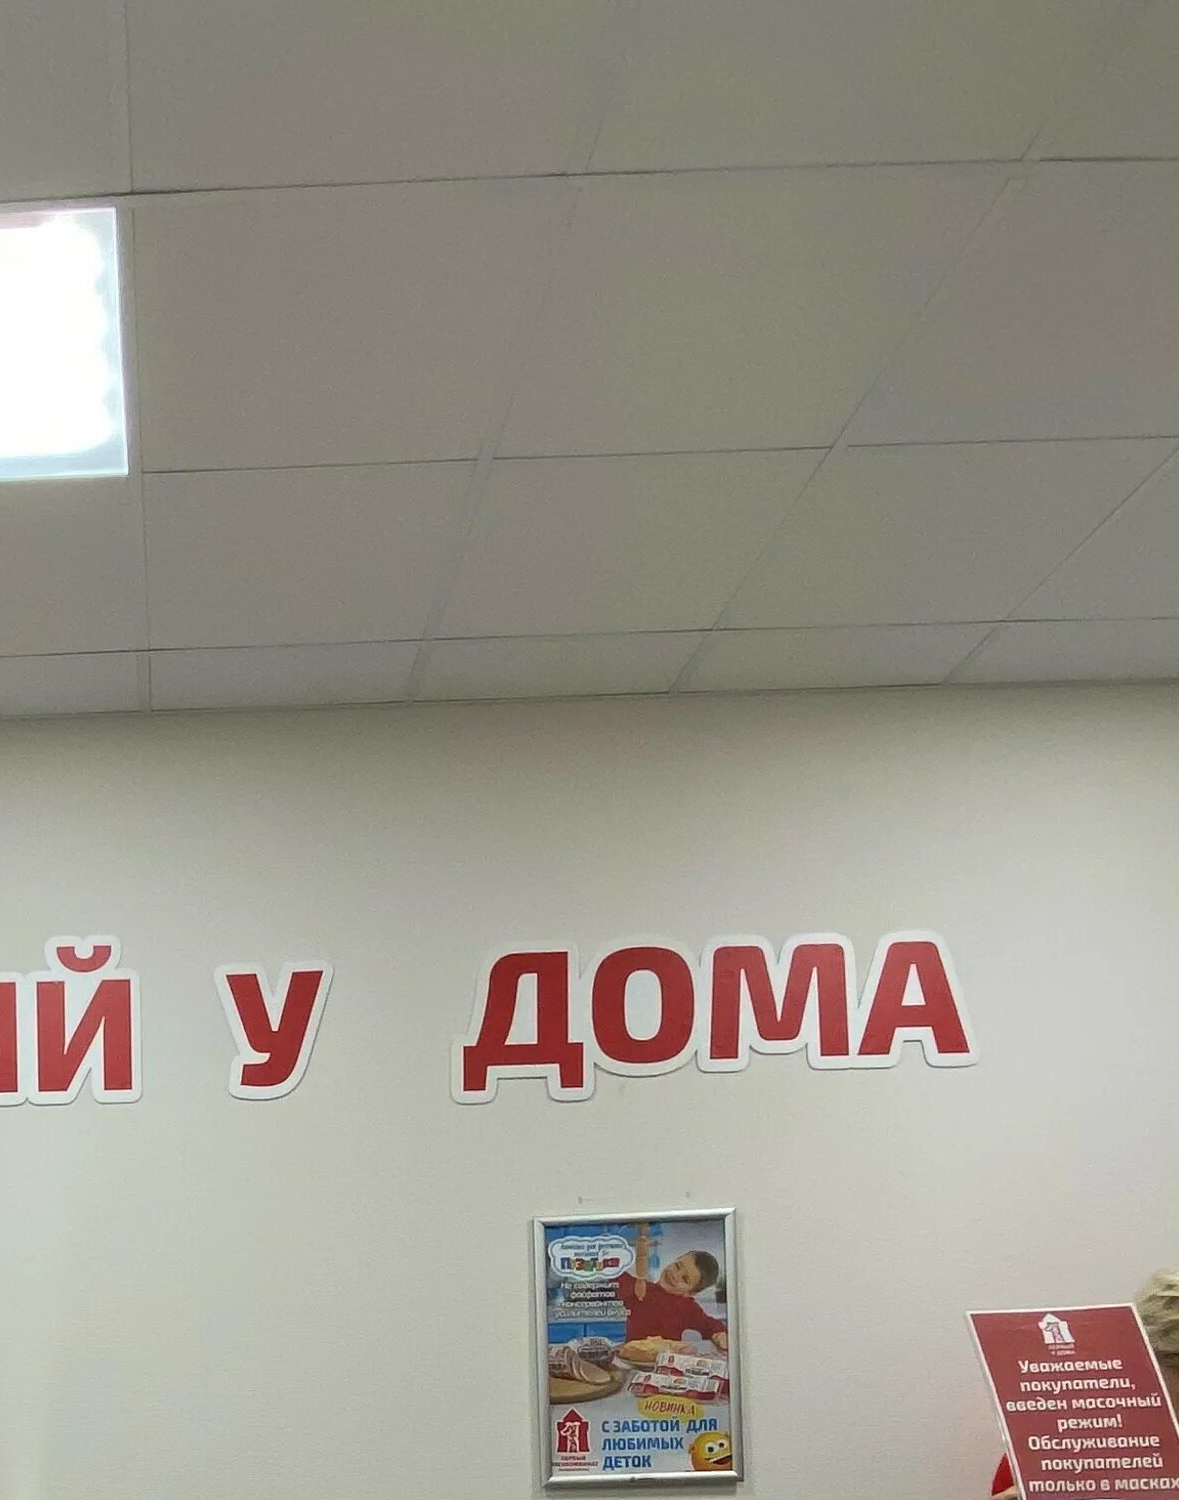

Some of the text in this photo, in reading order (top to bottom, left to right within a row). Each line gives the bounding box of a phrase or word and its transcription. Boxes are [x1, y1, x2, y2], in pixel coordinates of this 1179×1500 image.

[225, 968, 324, 1088] У
[461, 940, 971, 1093] ДОМА
[1017, 1358, 1123, 1374] Уважаемые
[1020, 1378, 1136, 1395] покупатели,
[644, 1401, 695, 1416] НОВИНКА
[1006, 1392, 1162, 1412] введен масочный
[601, 1417, 718, 1434] С ЗАБОТОЙ ДЛЯ
[1057, 1413, 1123, 1433] режим!
[602, 1437, 684, 1451] ЛЮБИМЫХ
[1028, 1435, 1161, 1453] Обслуживание
[602, 1455, 652, 1471] ДЕТОК
[1041, 1453, 1164, 1474] покупателей
[1029, 1478, 1096, 1492] только
[1100, 1479, 1111, 1491] в
